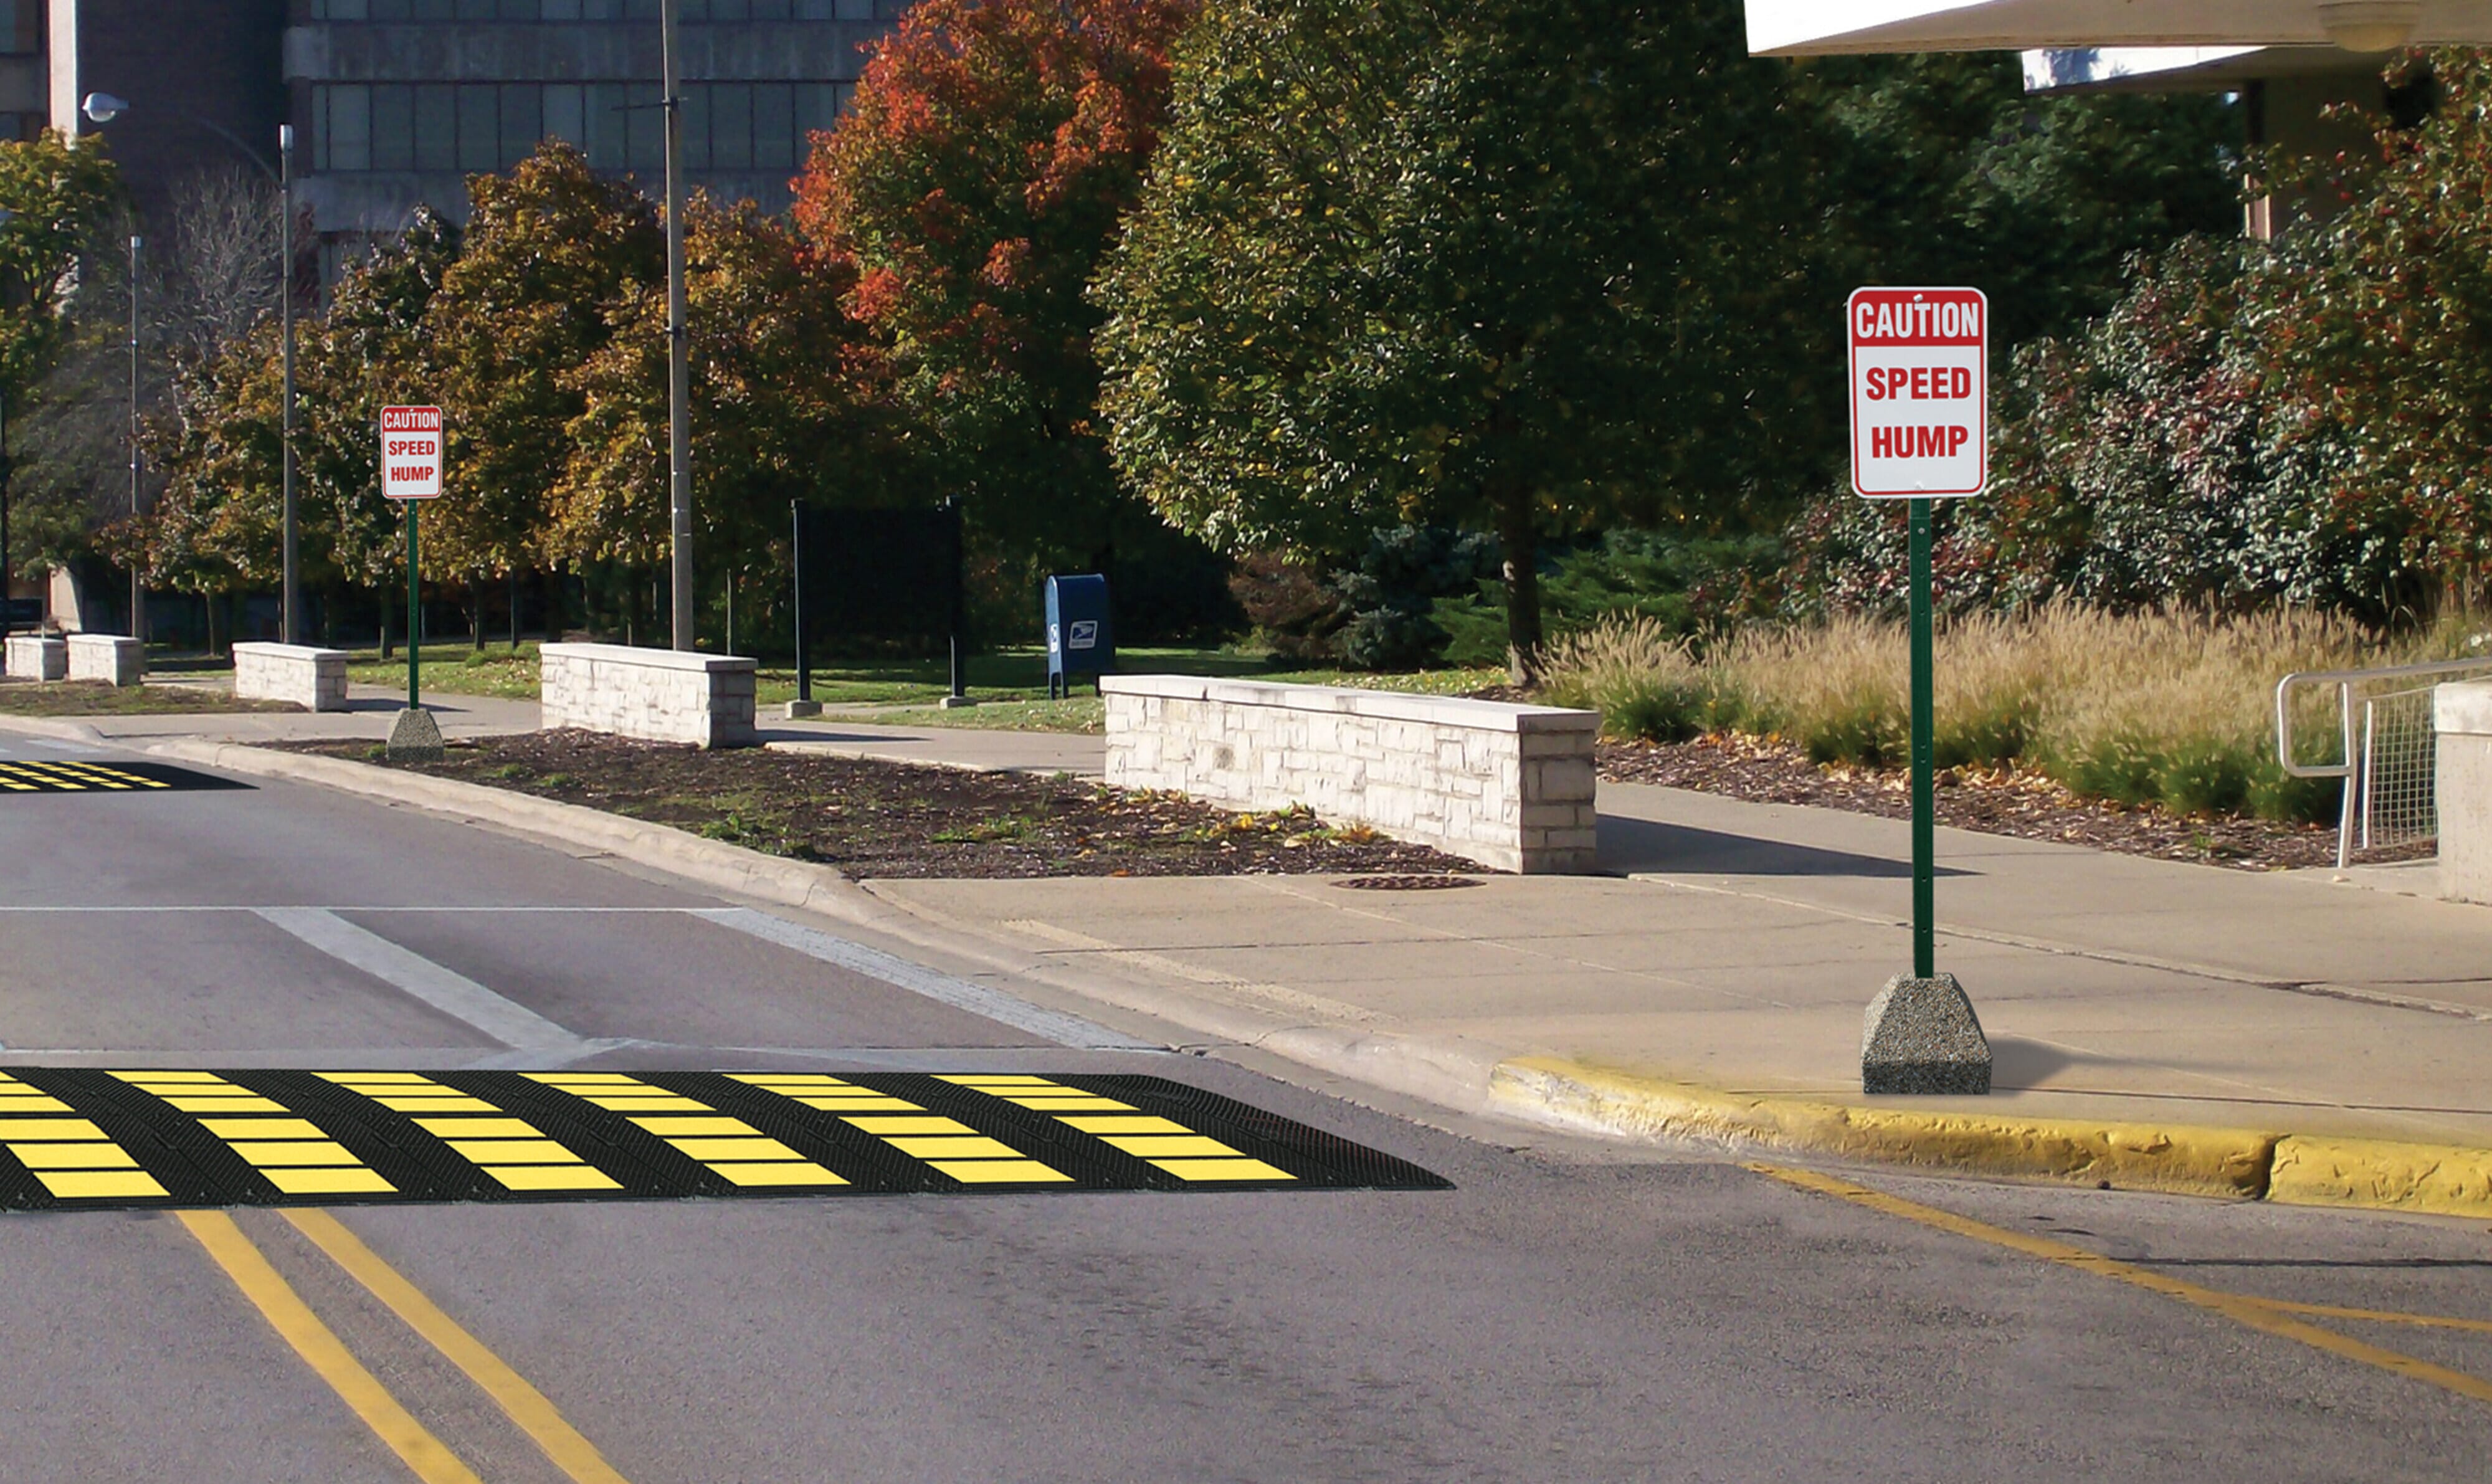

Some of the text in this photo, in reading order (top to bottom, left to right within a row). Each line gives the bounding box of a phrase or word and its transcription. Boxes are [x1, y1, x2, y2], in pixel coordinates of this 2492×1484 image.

[1856, 302, 1978, 338] CAUTION
[1867, 367, 1971, 400] SPEED
[384, 412, 439, 428] CAUTION
[389, 440, 435, 456] SPEED
[1872, 426, 1968, 458] HUMP
[391, 467, 434, 481] HUMP
